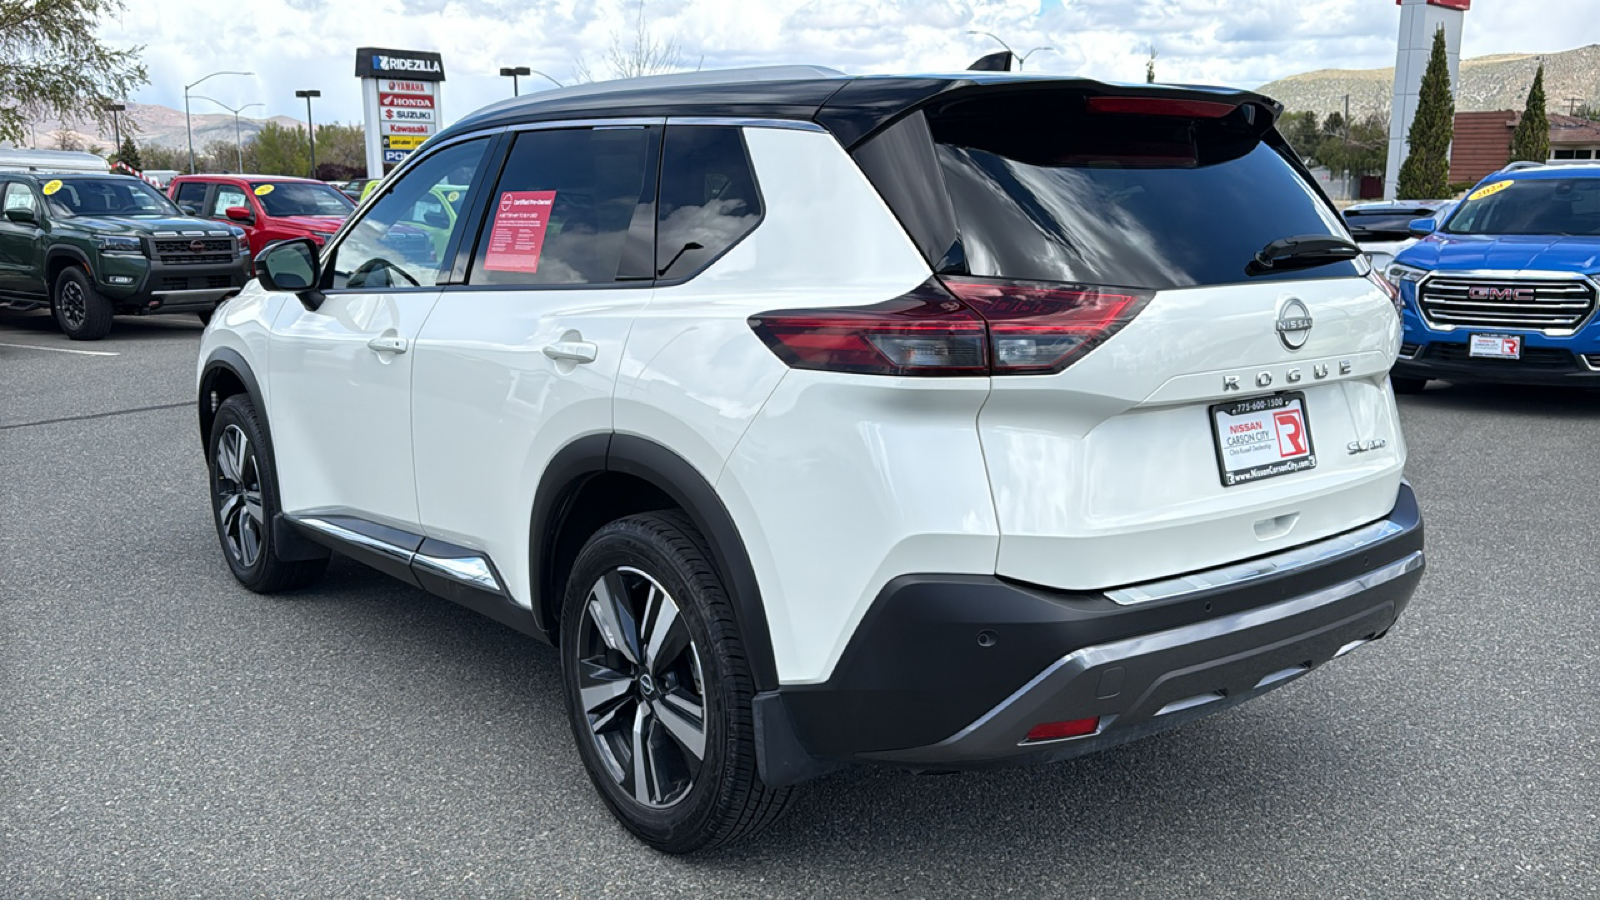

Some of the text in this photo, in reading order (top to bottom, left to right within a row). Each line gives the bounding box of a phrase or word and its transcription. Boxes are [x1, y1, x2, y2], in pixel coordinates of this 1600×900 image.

[389, 57, 441, 73] RIDEZILLA
[397, 81, 425, 92] YAMAHA
[393, 98, 431, 107] HONDA
[396, 110, 431, 119] SUZUKI
[390, 124, 428, 133] Kawasaki
[1469, 286, 1535, 300] GMC
[1277, 317, 1313, 331] NISSAN
[1223, 359, 1352, 391] ROGUE
[1236, 398, 1283, 412] 775-600-1500
[1229, 421, 1262, 434] NISSAN
[1226, 430, 1270, 446] CARSON CITY
